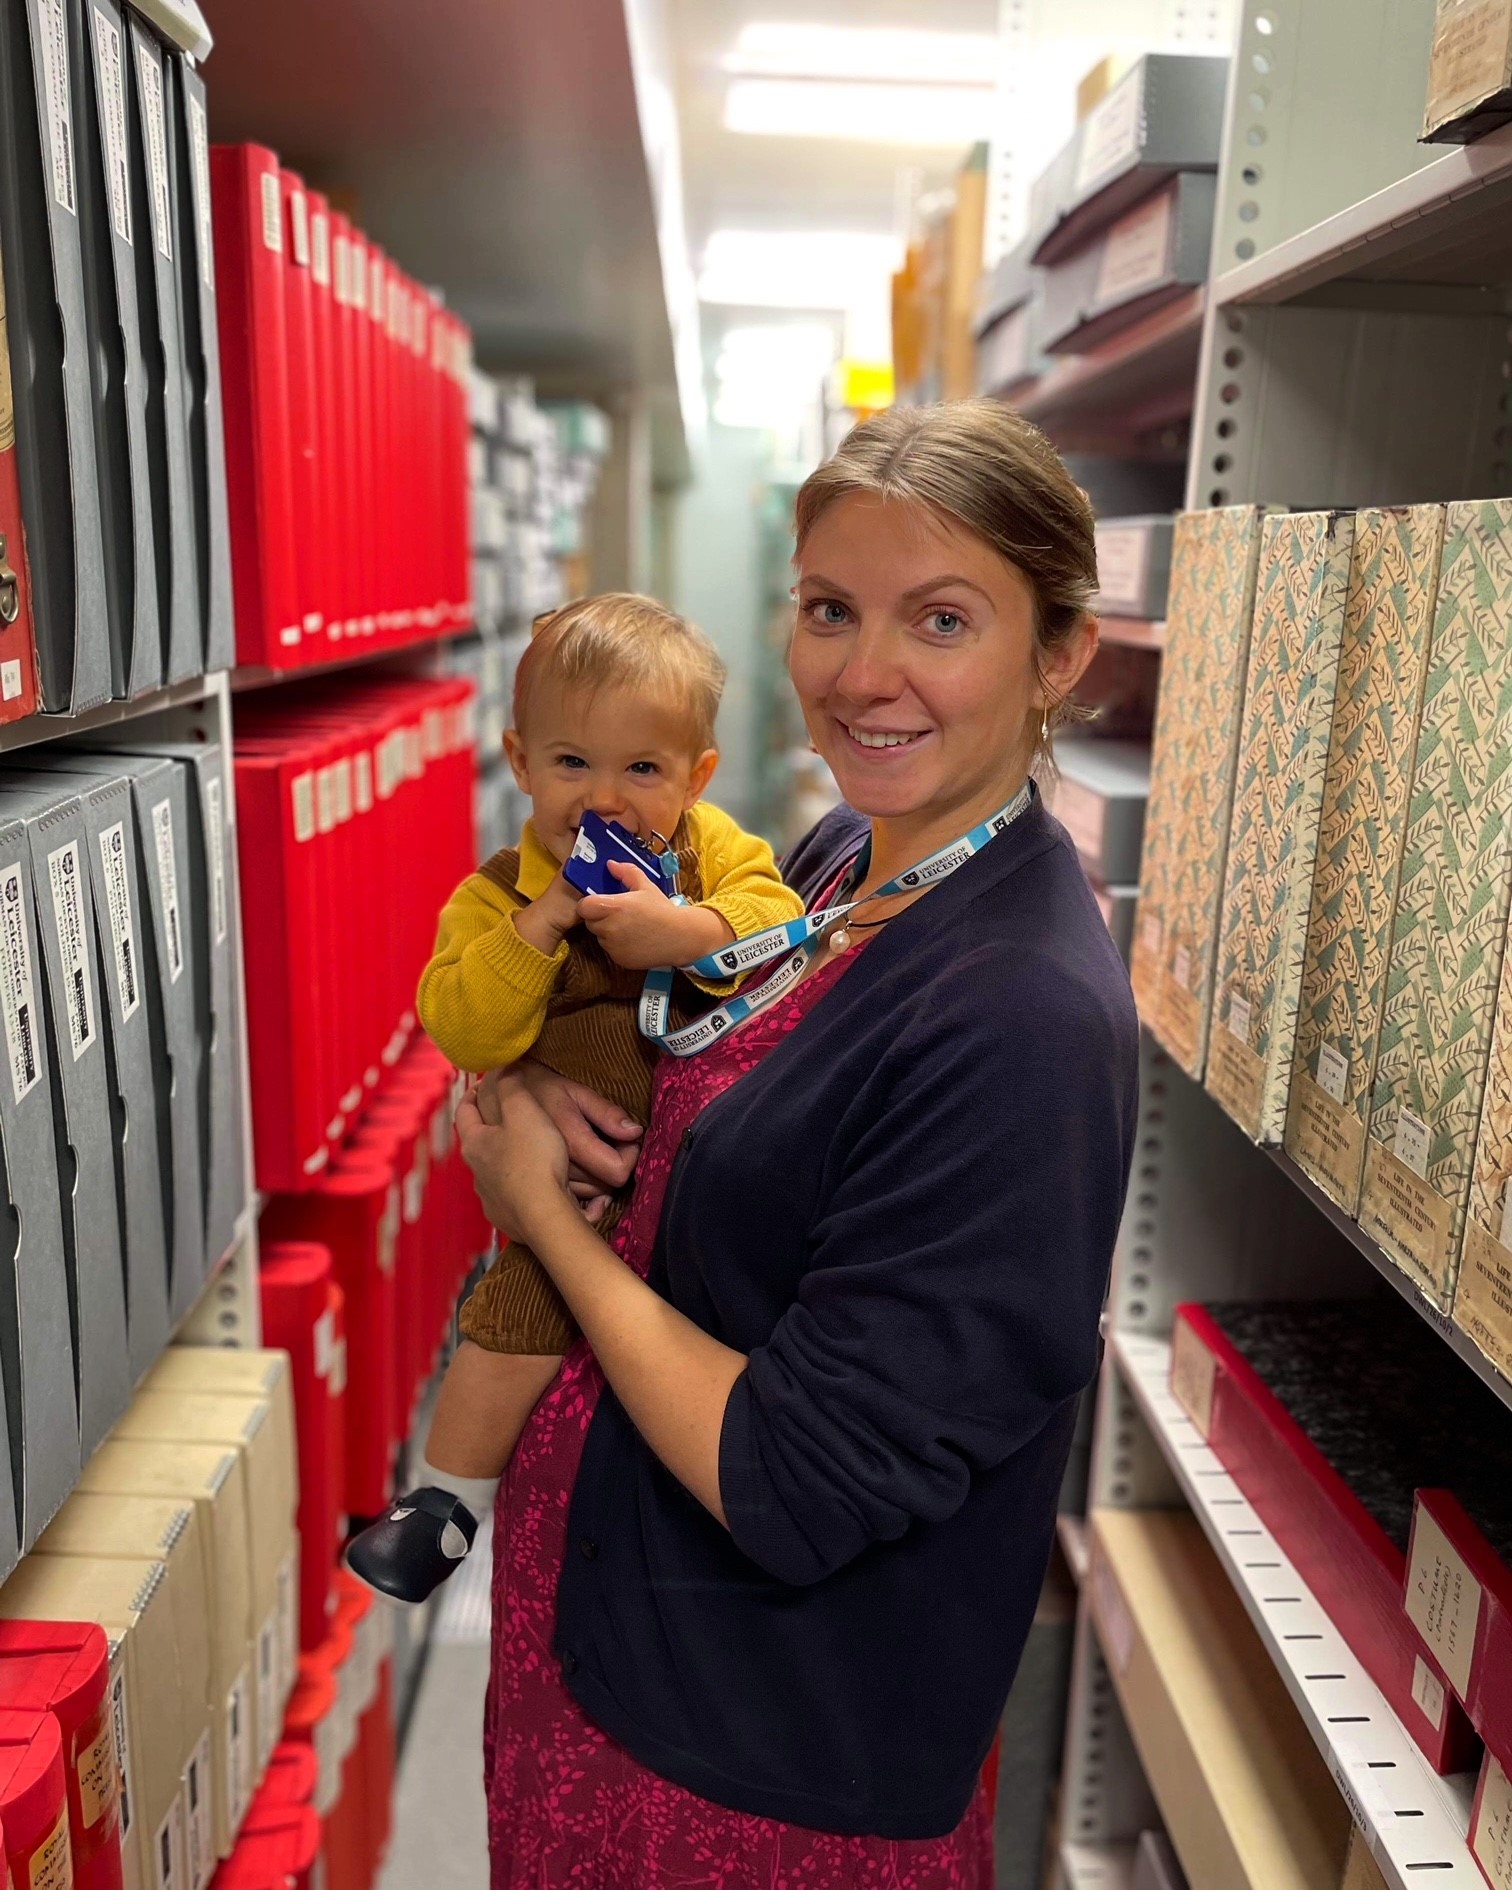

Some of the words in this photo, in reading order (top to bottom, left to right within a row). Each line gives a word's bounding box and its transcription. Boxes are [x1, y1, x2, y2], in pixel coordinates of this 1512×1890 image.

[919, 851, 956, 874] UNIVERSITY
[957, 846, 966, 855] OF
[921, 851, 971, 879] LEICESTER
[69, 874, 80, 935] University
[113, 855, 125, 936] Leicester
[63, 877, 78, 964] Leicester
[6, 903, 23, 1001] Leicester
[14, 900, 25, 969] University
[21, 968, 27, 986] of
[737, 936, 773, 956] UNIVERSITY
[774, 933, 782, 941] OF
[739, 938, 785, 964] LEICESTER
[667, 1025, 709, 1047] LEICESTER
[1377, 1171, 1412, 1209] SEVENTEENTH
[1413, 1204, 1436, 1232] CENTURY
[1392, 1171, 1404, 1188] LIFE
[1414, 1189, 1425, 1206] THE
[1389, 1196, 1423, 1234] ILLUSTRATED
[1496, 1262, 1511, 1282] LIFE
[1425, 1550, 1441, 1636] COSTUME
